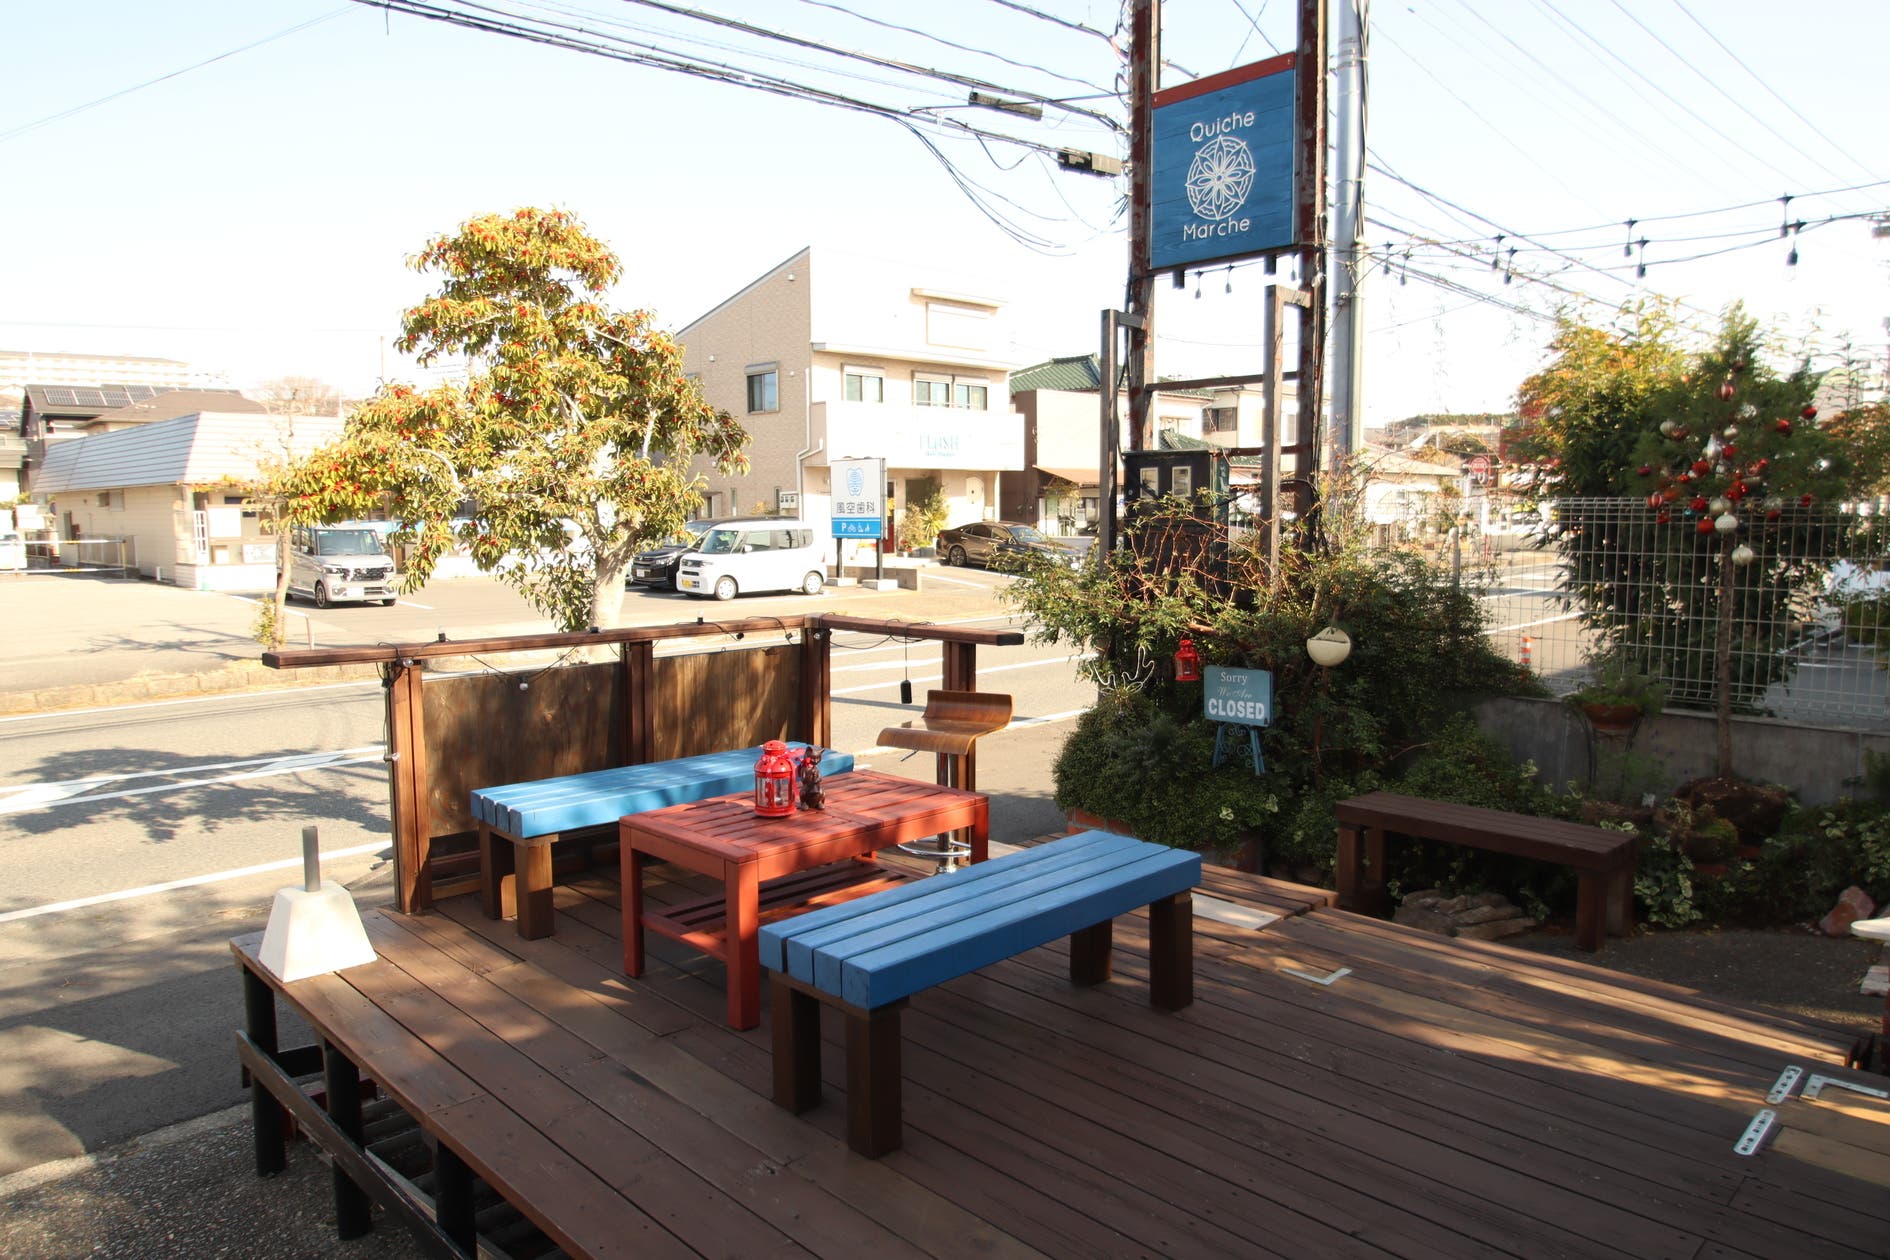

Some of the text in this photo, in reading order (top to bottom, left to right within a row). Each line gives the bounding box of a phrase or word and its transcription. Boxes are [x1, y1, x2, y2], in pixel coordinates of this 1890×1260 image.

[1190, 111, 1255, 142] Quiche
[1183, 217, 1250, 241] Marche
[1220, 671, 1248, 686] Sorry
[1208, 698, 1265, 719] CLOSED
